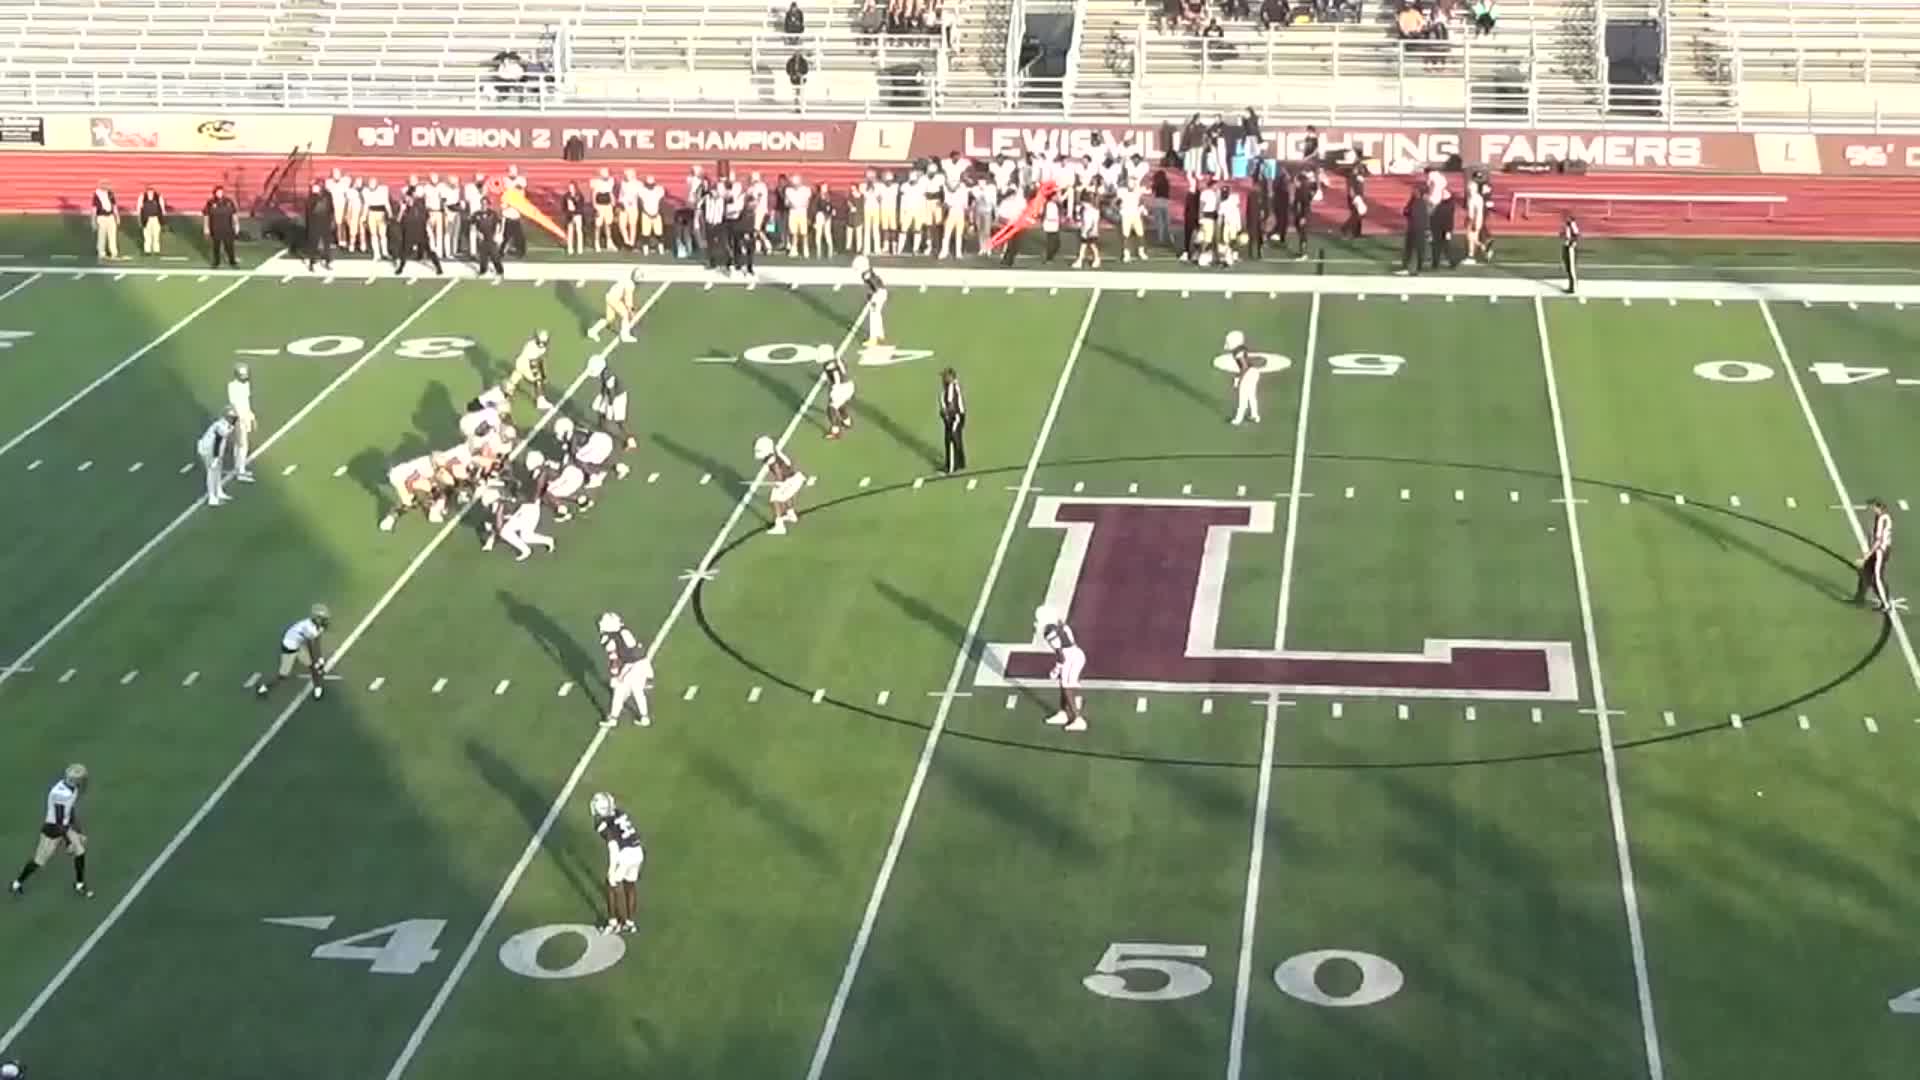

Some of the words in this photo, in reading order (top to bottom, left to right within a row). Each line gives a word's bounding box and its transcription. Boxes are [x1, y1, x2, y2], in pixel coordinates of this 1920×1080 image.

[411, 126, 519, 148] DIVISION
[532, 128, 551, 149] 2
[664, 130, 824, 151] CHAMPIONS
[878, 127, 891, 149] L
[964, 127, 1182, 158] LEWISVIL
[1479, 134, 1703, 168] FARMERS
[1783, 141, 1797, 162] L
[973, 496, 1580, 702] L
